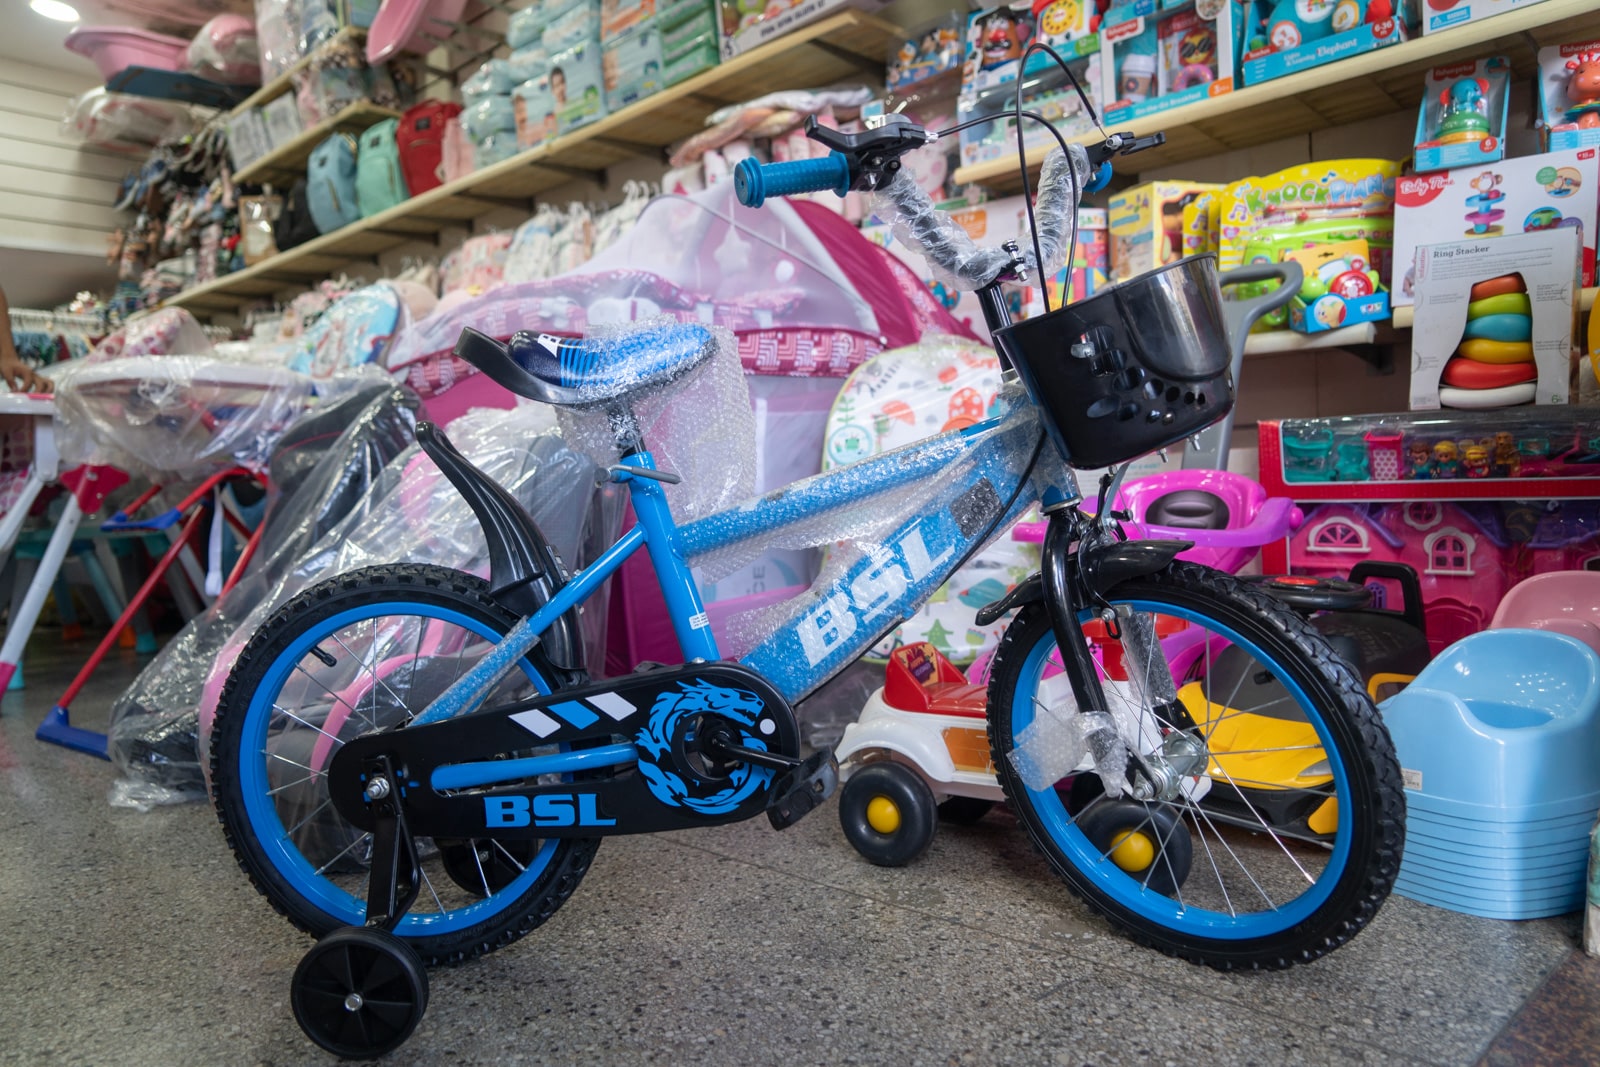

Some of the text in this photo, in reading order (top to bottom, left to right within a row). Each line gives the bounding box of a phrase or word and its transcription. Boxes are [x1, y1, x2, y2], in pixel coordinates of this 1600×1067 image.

[1317, 38, 1358, 58] Elephant
[1562, 42, 1600, 53] fisher-pric
[1400, 173, 1455, 196] Baby Time
[1245, 182, 1330, 214] KNOCK
[1455, 245, 1491, 256] Stacker
[796, 526, 955, 669] BSL
[483, 793, 617, 828] BSL
